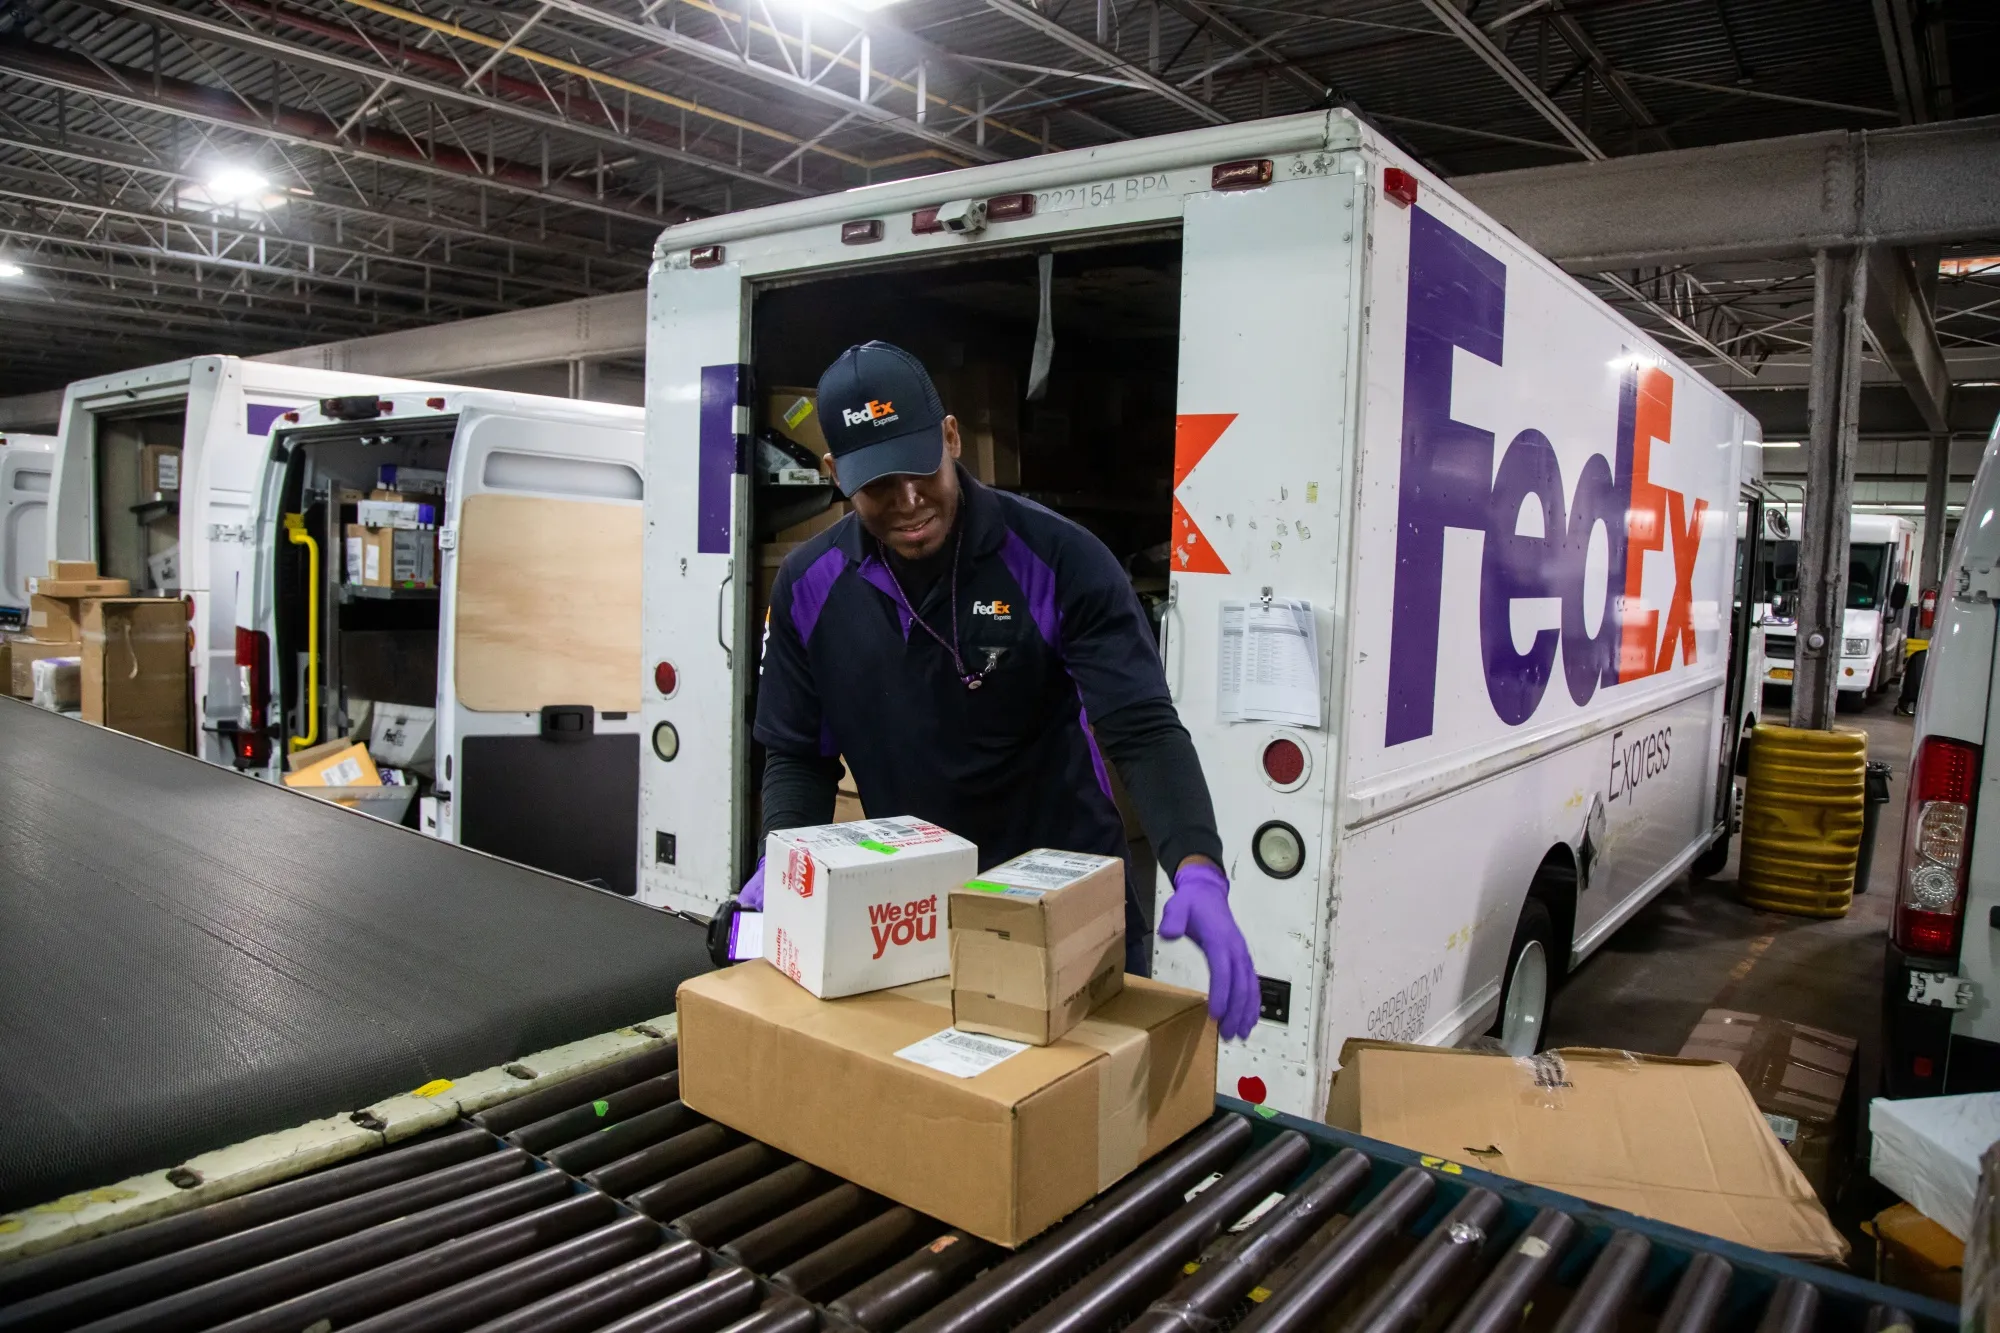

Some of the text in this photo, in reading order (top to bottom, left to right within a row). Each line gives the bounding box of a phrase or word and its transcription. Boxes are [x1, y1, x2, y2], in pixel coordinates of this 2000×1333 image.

[842, 399, 896, 427] FedEx
[873, 414, 899, 427] Express
[1385, 204, 1708, 748] FedEx
[972, 600, 1011, 615] FedEx
[1608, 725, 1672, 807] Express
[794, 850, 808, 894] STOP
[868, 894, 938, 925] We get
[870, 914, 937, 960] you
[1367, 987, 1409, 1032] GARDEN
[1432, 961, 1445, 986] NY
